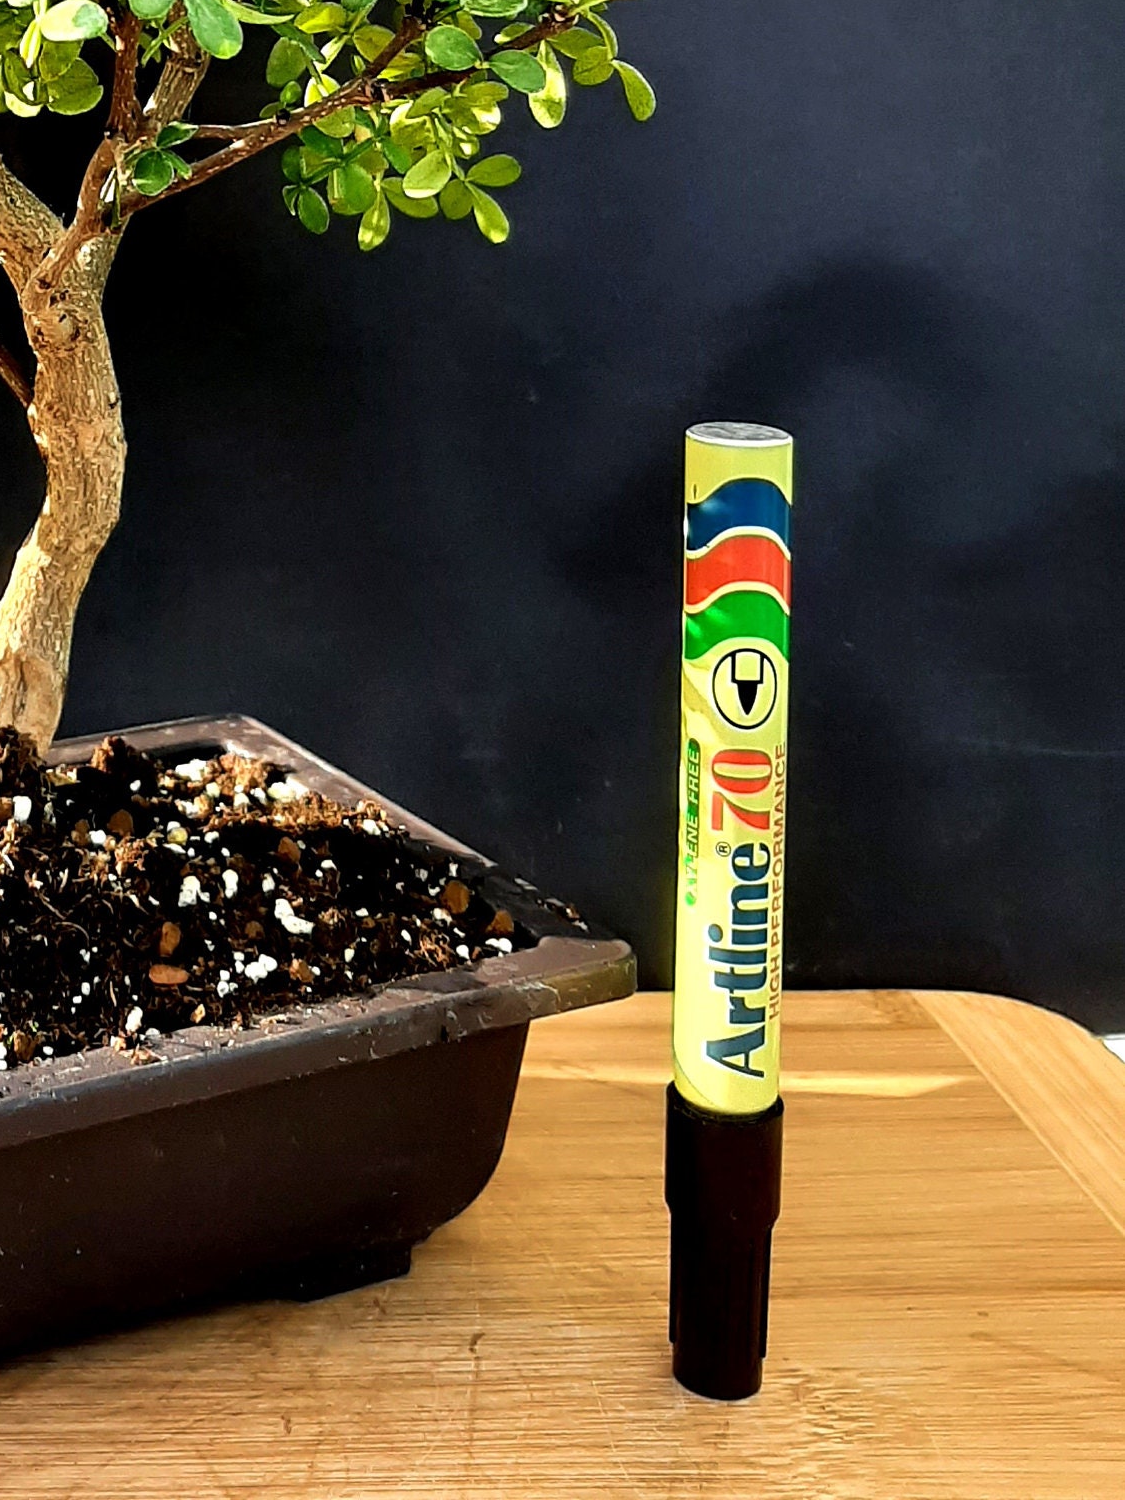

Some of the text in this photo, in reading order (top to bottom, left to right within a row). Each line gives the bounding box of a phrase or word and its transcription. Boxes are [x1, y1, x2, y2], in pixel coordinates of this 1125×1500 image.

[687, 748, 700, 804] FREE
[711, 749, 773, 832] 70
[769, 741, 786, 1020] HIGH PERFORMANCE
